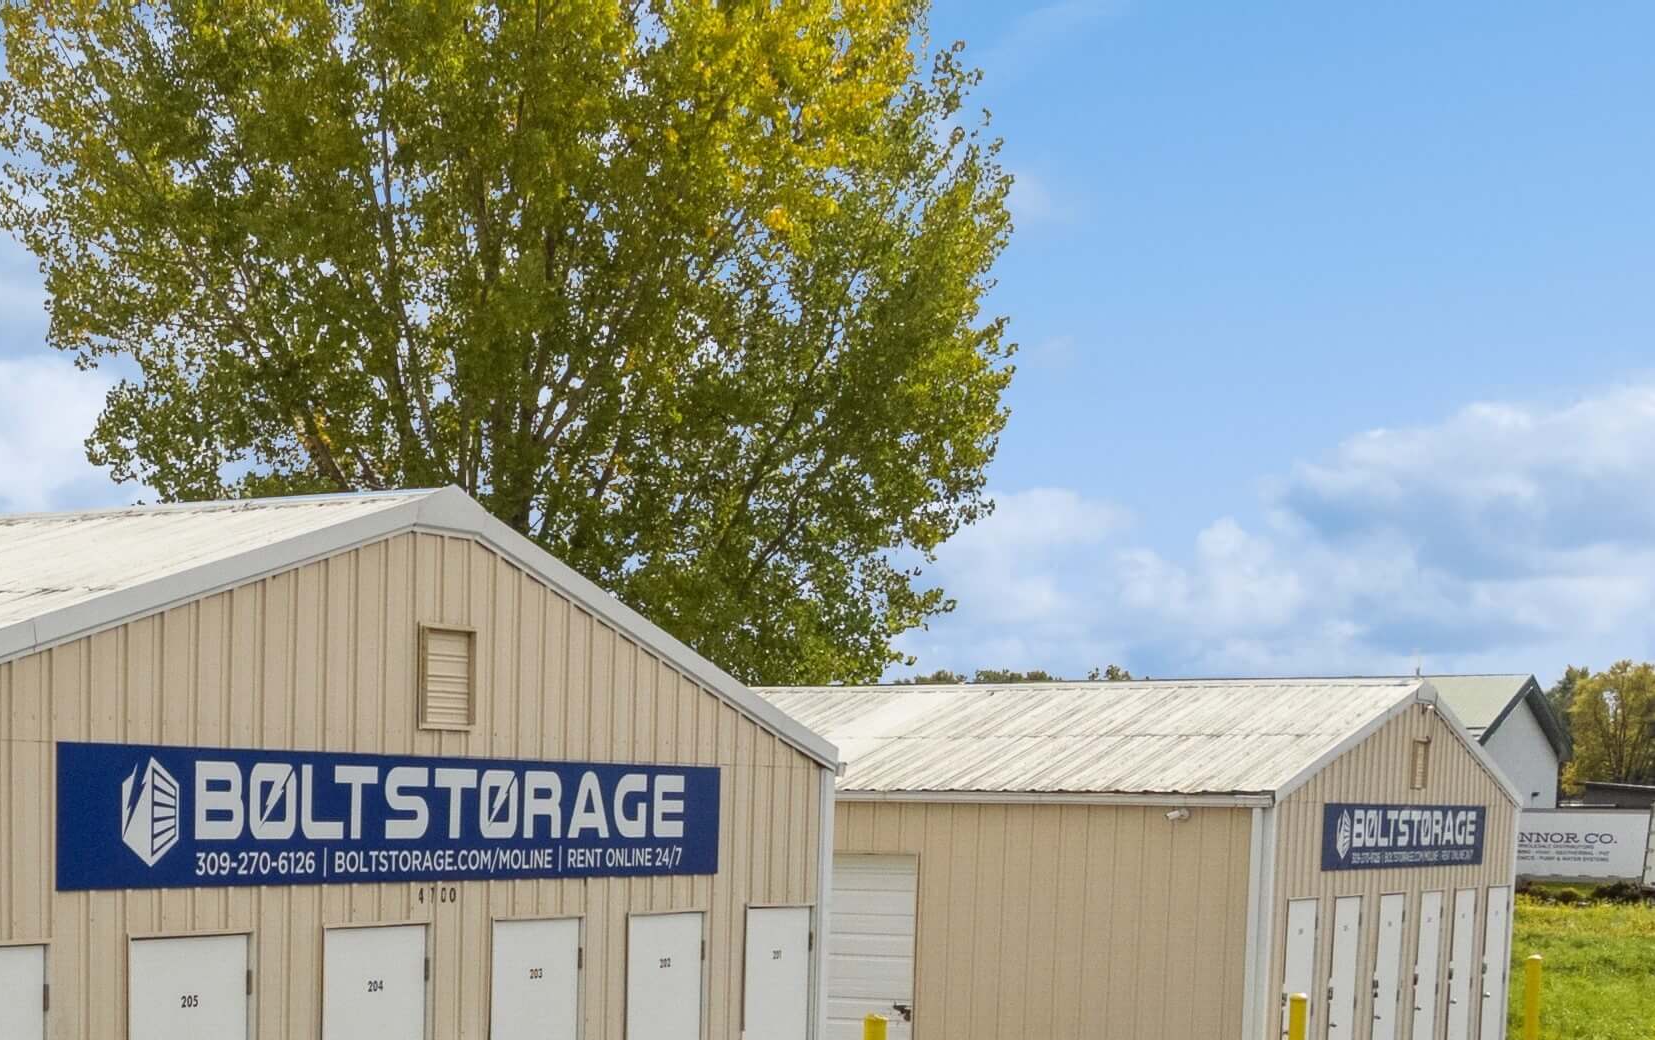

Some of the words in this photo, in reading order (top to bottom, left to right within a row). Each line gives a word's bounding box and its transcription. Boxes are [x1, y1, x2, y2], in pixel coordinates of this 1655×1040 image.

[1517, 831, 1580, 844] NNOR
[1584, 832, 1618, 845] CO.
[195, 851, 316, 876] 309-270-6126
[334, 847, 553, 874] BOLTSTORAGE.COM/MOLINE
[567, 848, 603, 869] RENT
[605, 847, 653, 868] ONLINE
[654, 844, 683, 869] 24/7
[367, 980, 384, 993] 204
[180, 994, 199, 1009] 205
